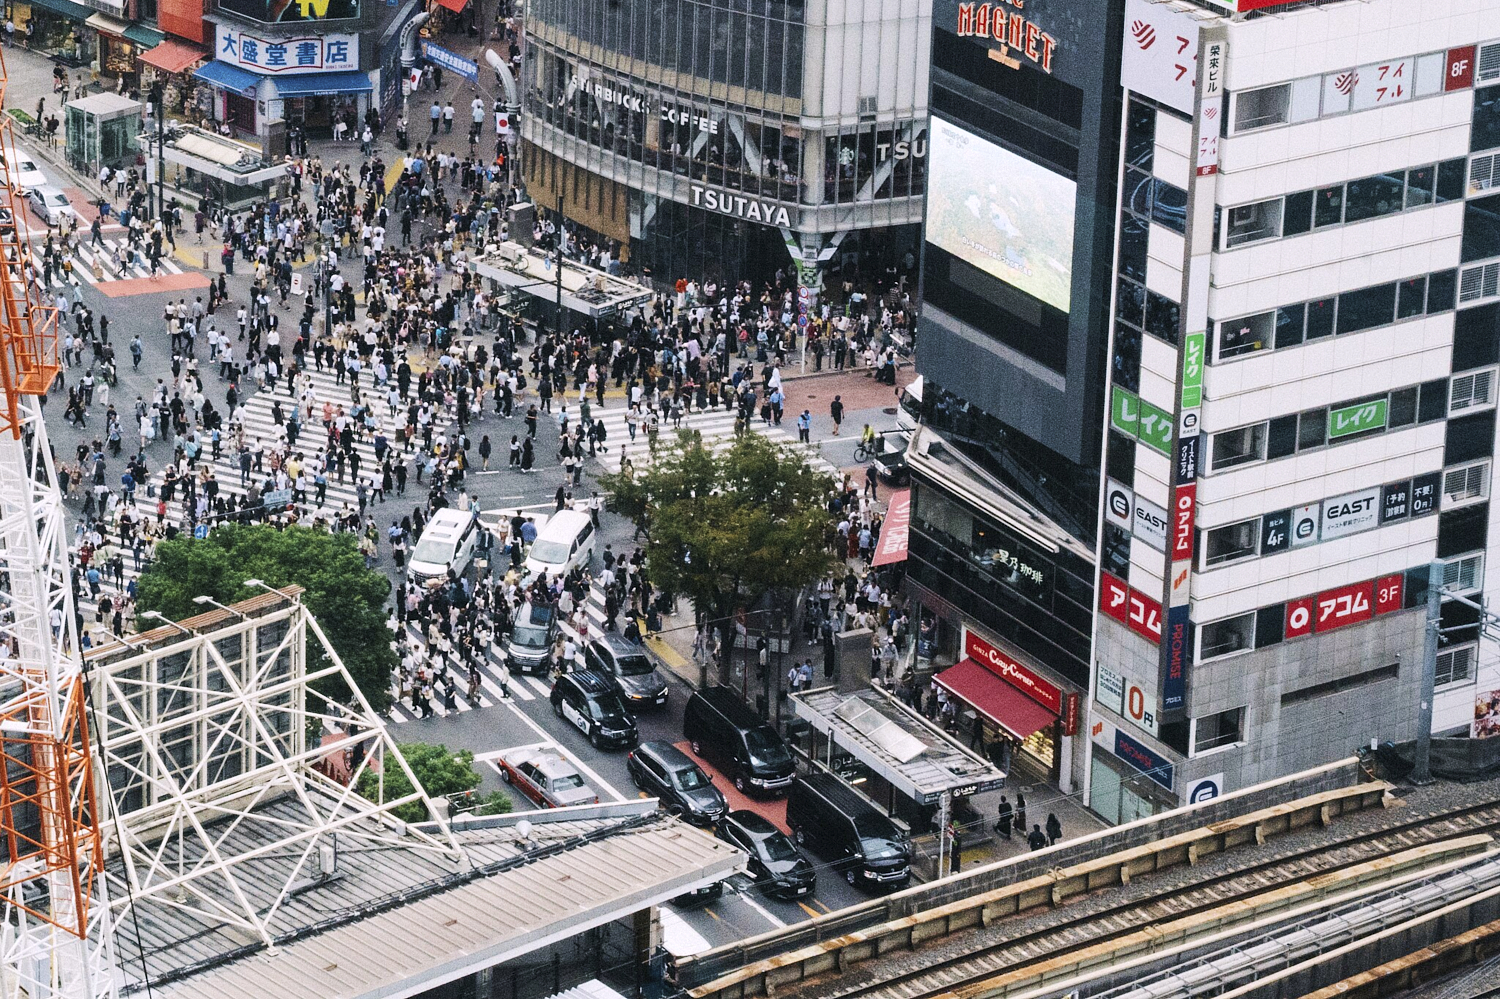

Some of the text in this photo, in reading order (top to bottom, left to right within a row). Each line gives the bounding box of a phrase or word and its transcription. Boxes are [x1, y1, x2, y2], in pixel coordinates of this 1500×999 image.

[222, 33, 350, 66] 大盛堂書店
[957, 2, 1057, 75] MAGNET
[1451, 59, 1468, 77] 8F
[570, 73, 719, 136] STARBUCKS COFFEE
[690, 184, 791, 229] TSUTAYA
[1187, 339, 1201, 379] レイク
[1336, 404, 1377, 430] レイク
[1327, 497, 1375, 520] EAST
[1176, 512, 1191, 550] アコム
[1267, 530, 1284, 547] 4F
[1319, 592, 1369, 622] アコム
[1379, 585, 1399, 604] 3F
[1169, 623, 1184, 680] PROMISE
